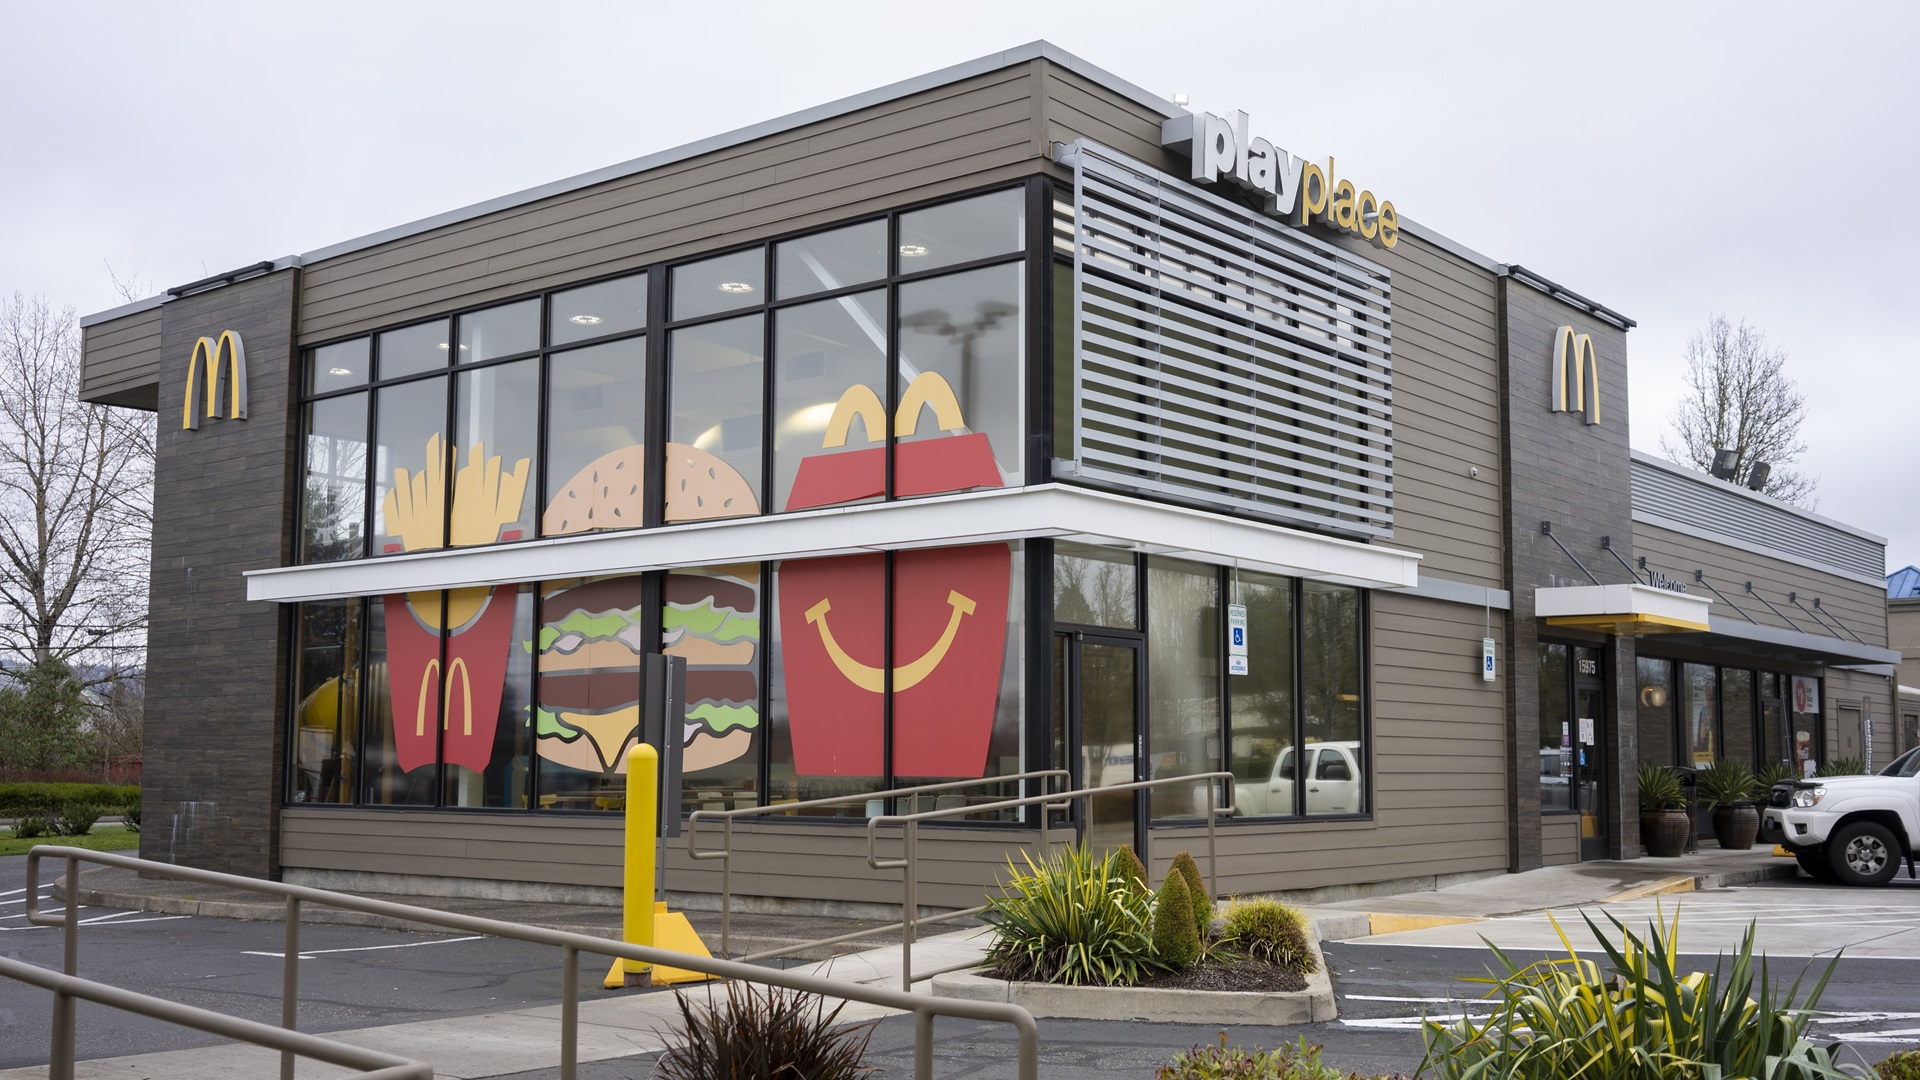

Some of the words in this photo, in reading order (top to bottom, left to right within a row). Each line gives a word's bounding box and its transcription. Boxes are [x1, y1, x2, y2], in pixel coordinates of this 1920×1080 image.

[1194, 109, 1398, 249] playplace
[1650, 571, 1687, 594] Welcome
[1578, 659, 1596, 674] 15975
